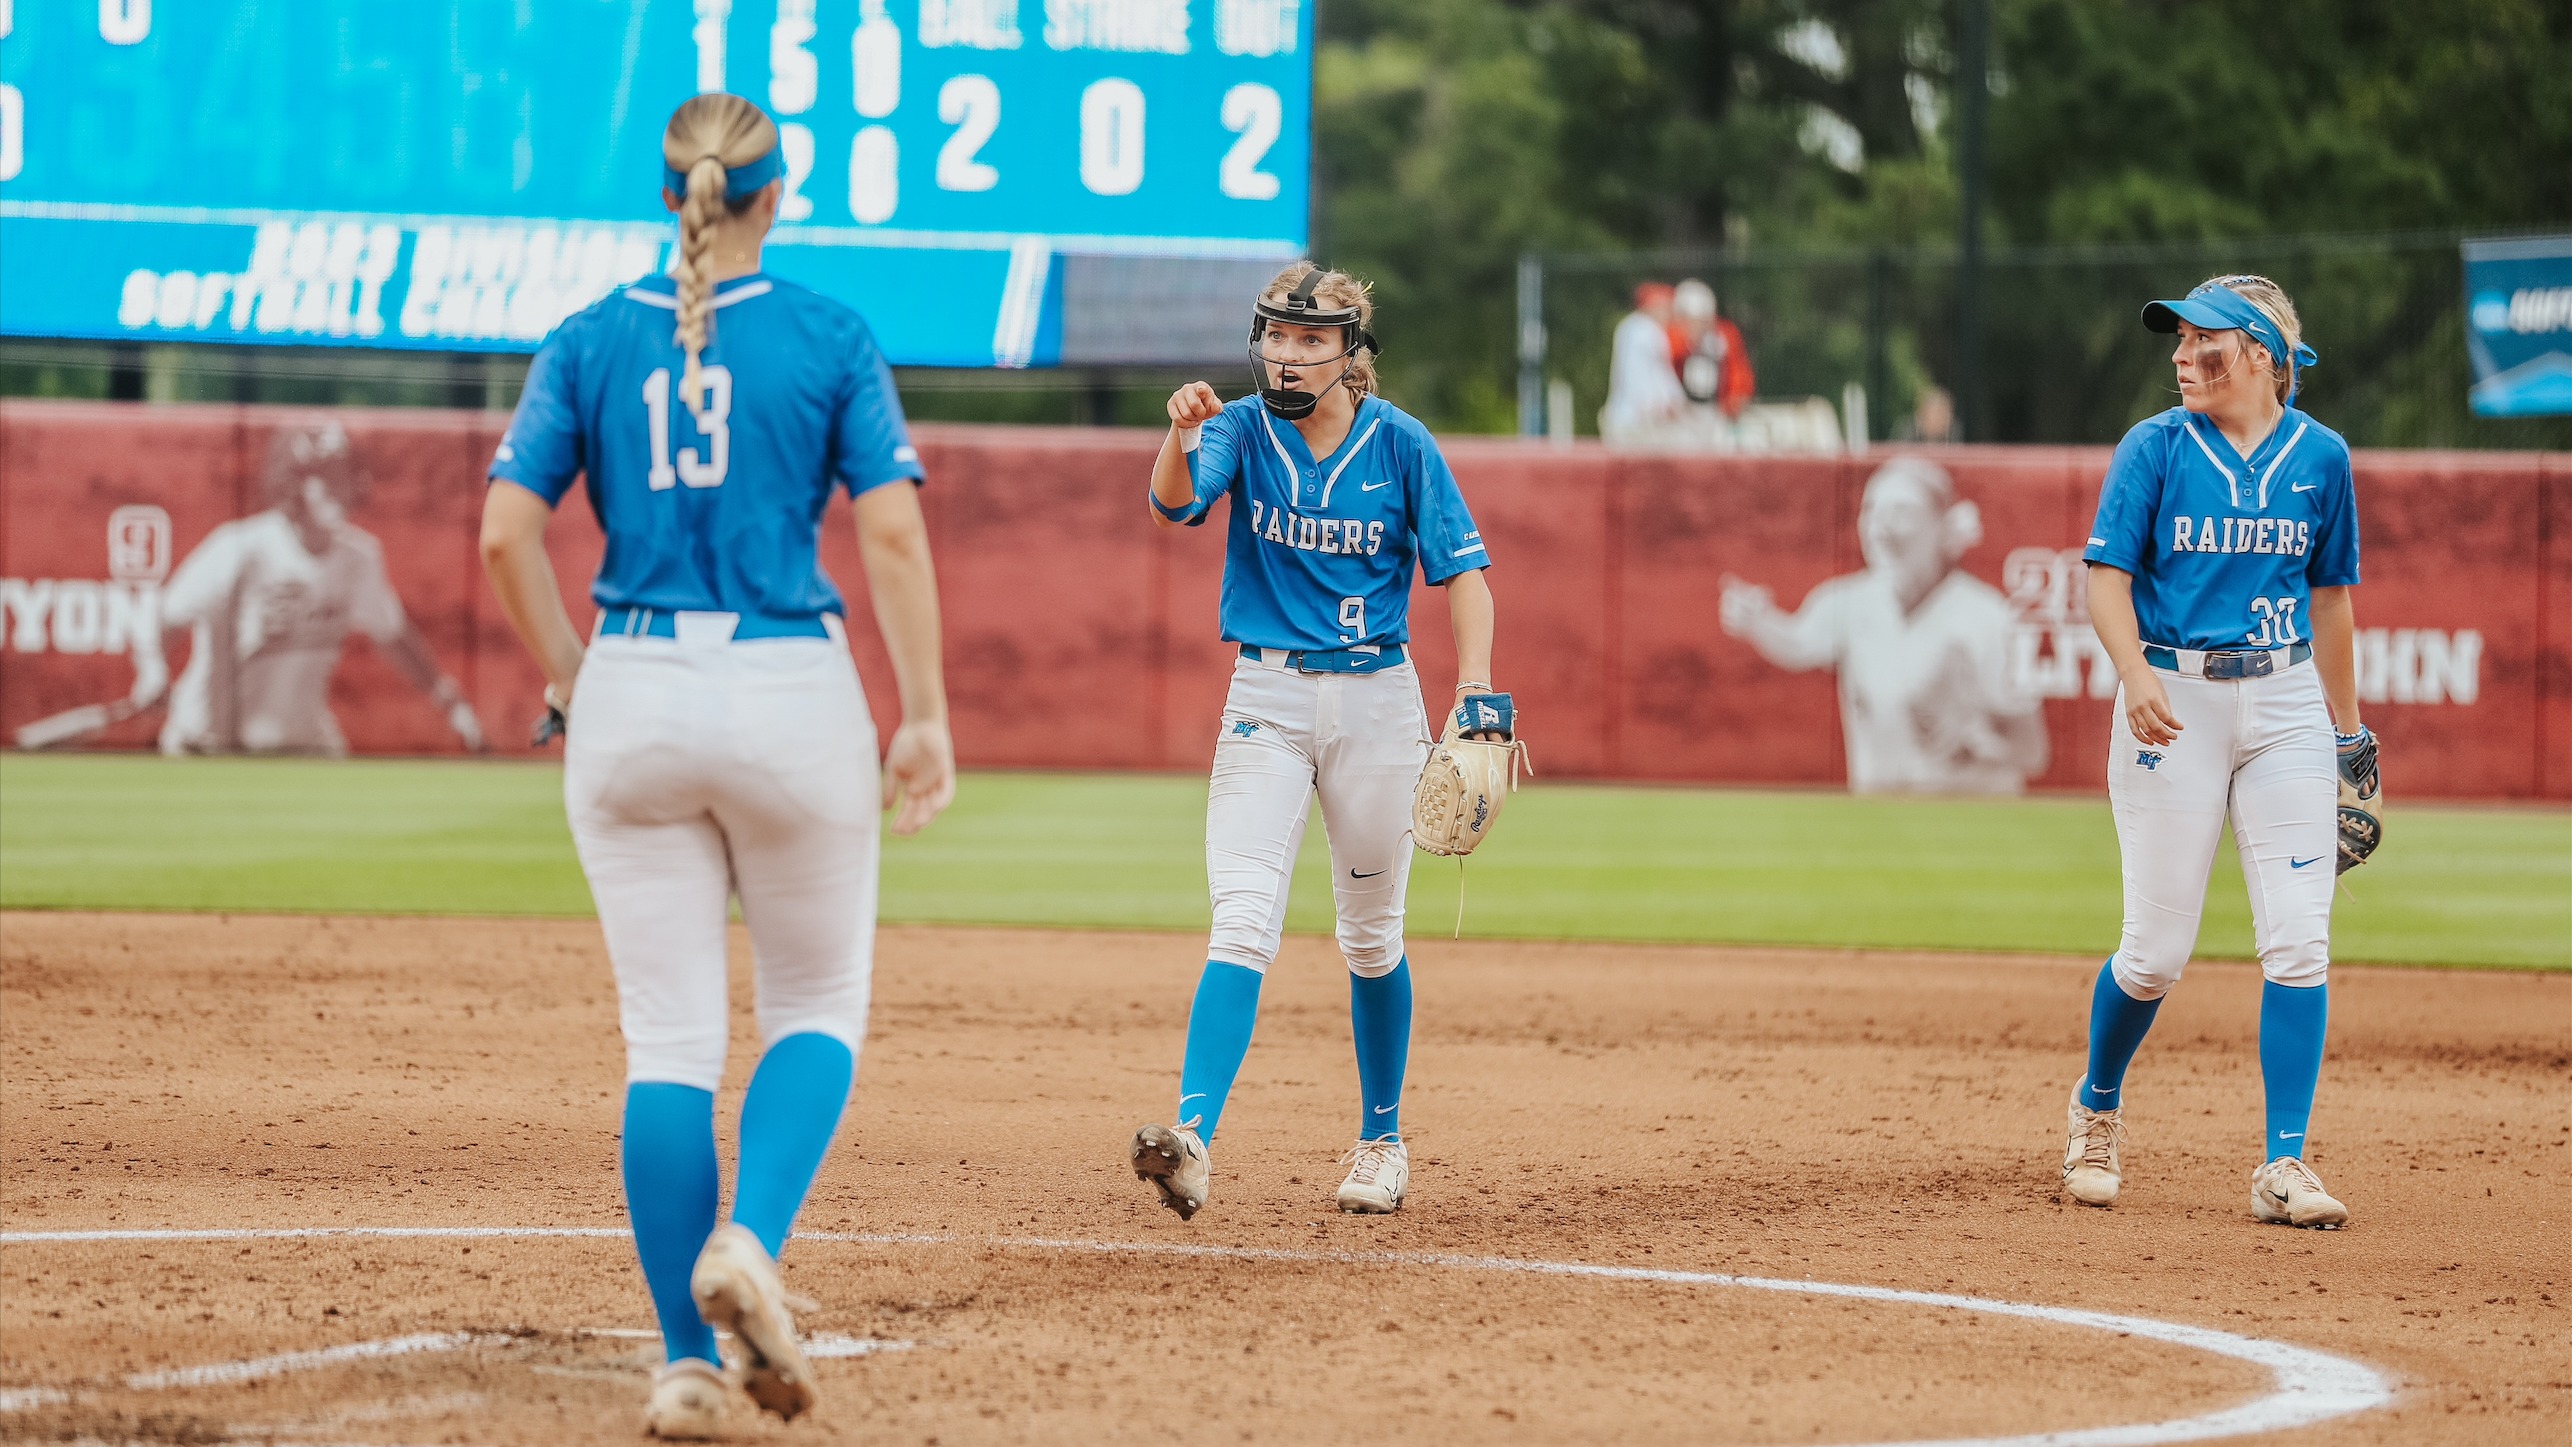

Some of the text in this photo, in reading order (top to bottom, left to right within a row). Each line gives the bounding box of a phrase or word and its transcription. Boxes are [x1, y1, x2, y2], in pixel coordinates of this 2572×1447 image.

[768, 17, 818, 114] 5
[937, 73, 1282, 200] 2 0 2
[641, 364, 733, 492] 13
[107, 504, 172, 580] 9
[1252, 499, 1384, 556] RAIDERS
[2172, 516, 2309, 556] RAIDERS
[0, 577, 164, 654] YON
[1337, 597, 1367, 643] 9
[2246, 596, 2300, 646] 30
